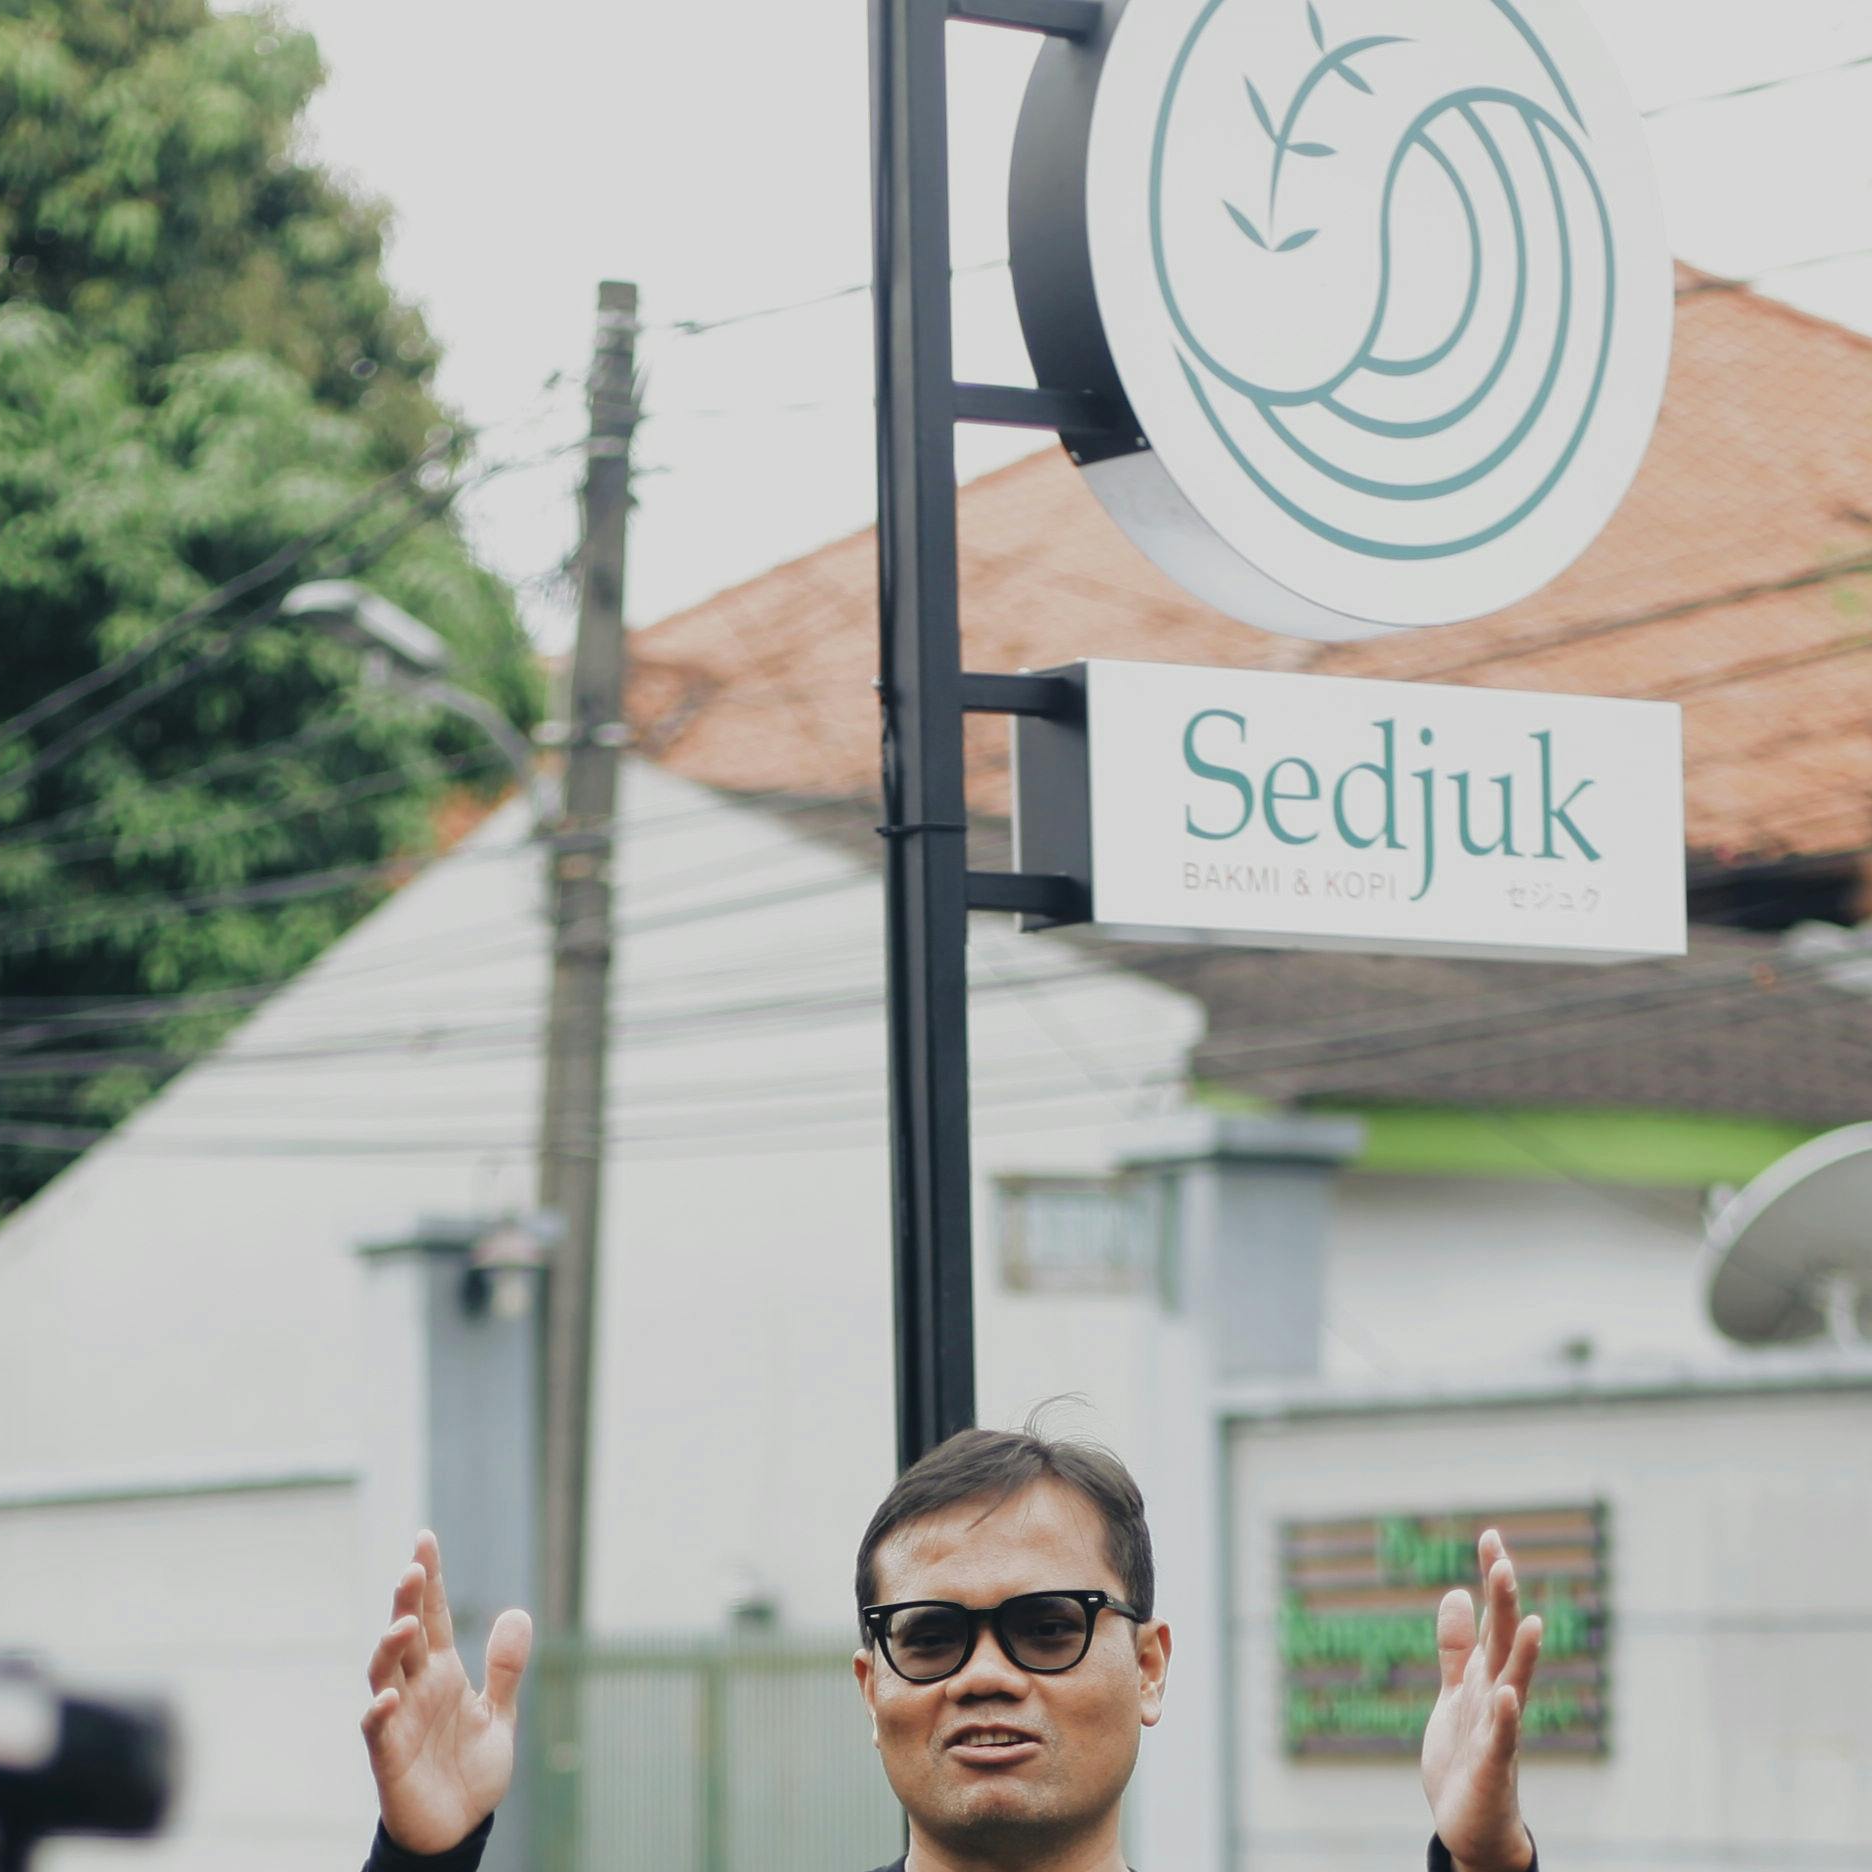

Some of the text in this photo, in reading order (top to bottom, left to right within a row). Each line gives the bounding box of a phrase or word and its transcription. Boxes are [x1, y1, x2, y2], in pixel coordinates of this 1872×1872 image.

[1182, 708, 1602, 901] Sedjuk
[1183, 861, 1398, 901] BAKMI & KOPI
